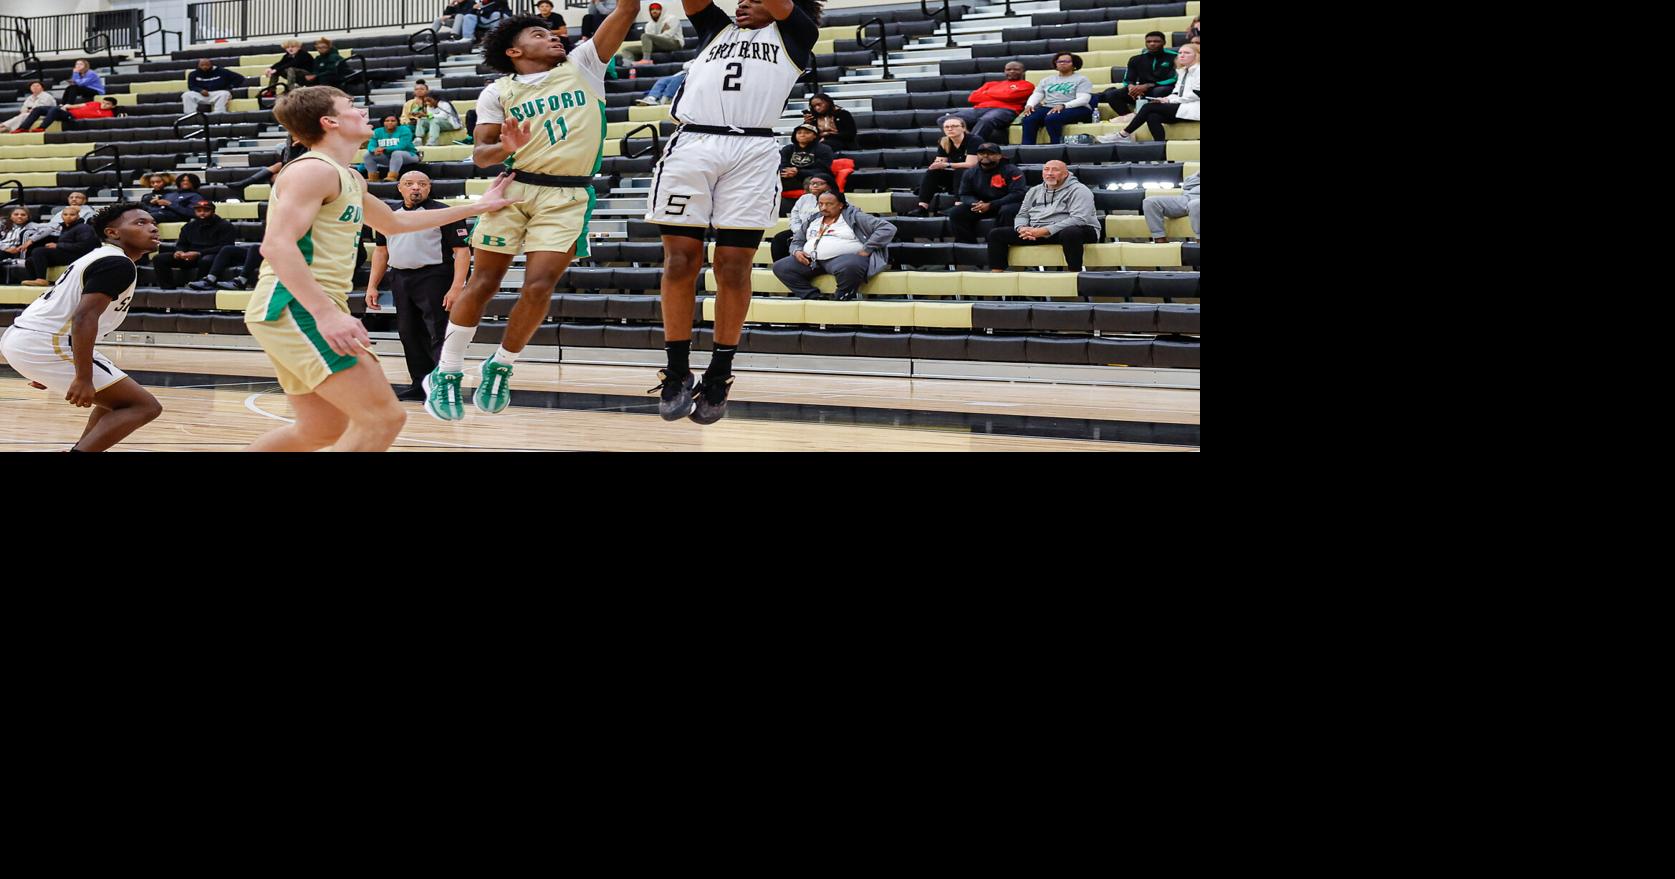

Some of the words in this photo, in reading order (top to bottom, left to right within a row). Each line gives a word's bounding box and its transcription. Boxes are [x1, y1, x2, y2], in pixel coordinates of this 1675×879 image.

[722, 62, 743, 91] 2
[509, 90, 586, 122] BUFORD
[543, 116, 568, 146] 11
[665, 195, 691, 215] S
[481, 234, 506, 246] B
